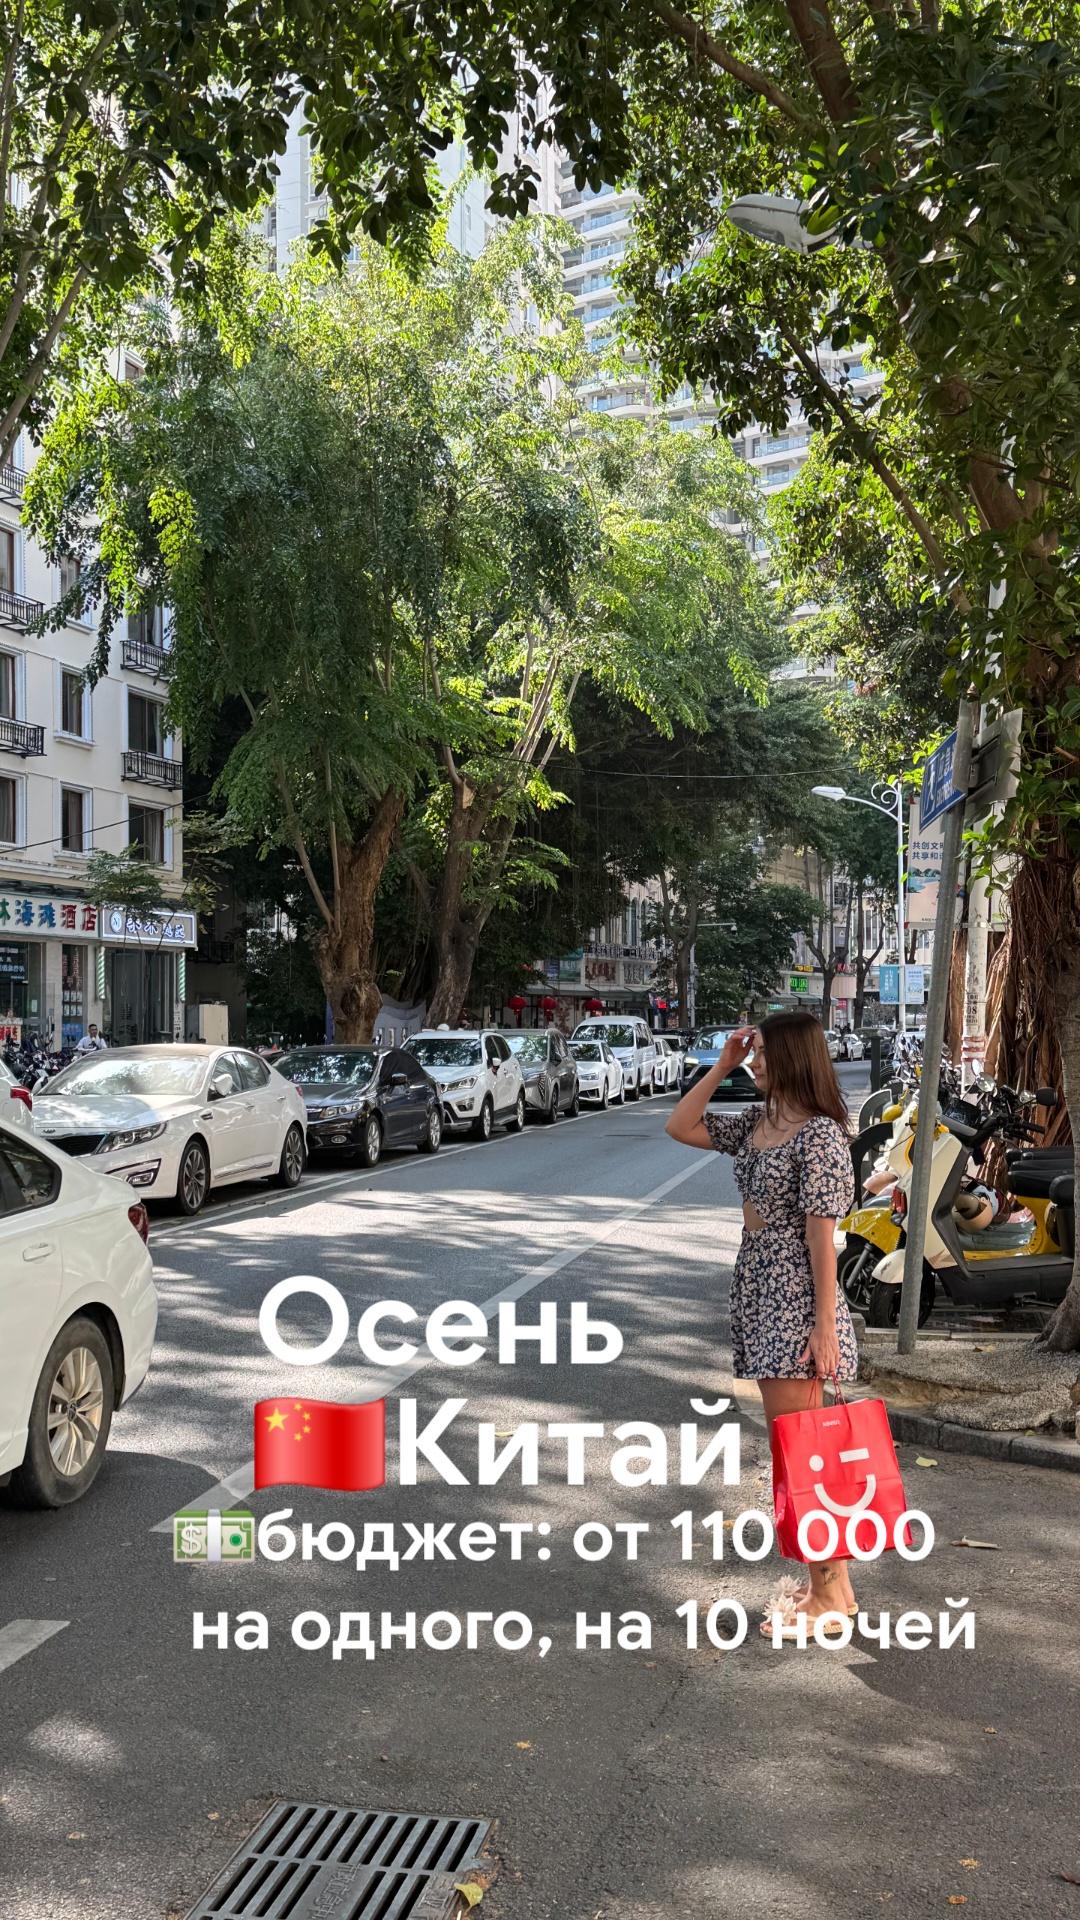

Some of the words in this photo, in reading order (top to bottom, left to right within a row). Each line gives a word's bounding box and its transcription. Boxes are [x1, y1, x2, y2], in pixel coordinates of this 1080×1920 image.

[307, 1863, 361, 1920] 市政应急中
